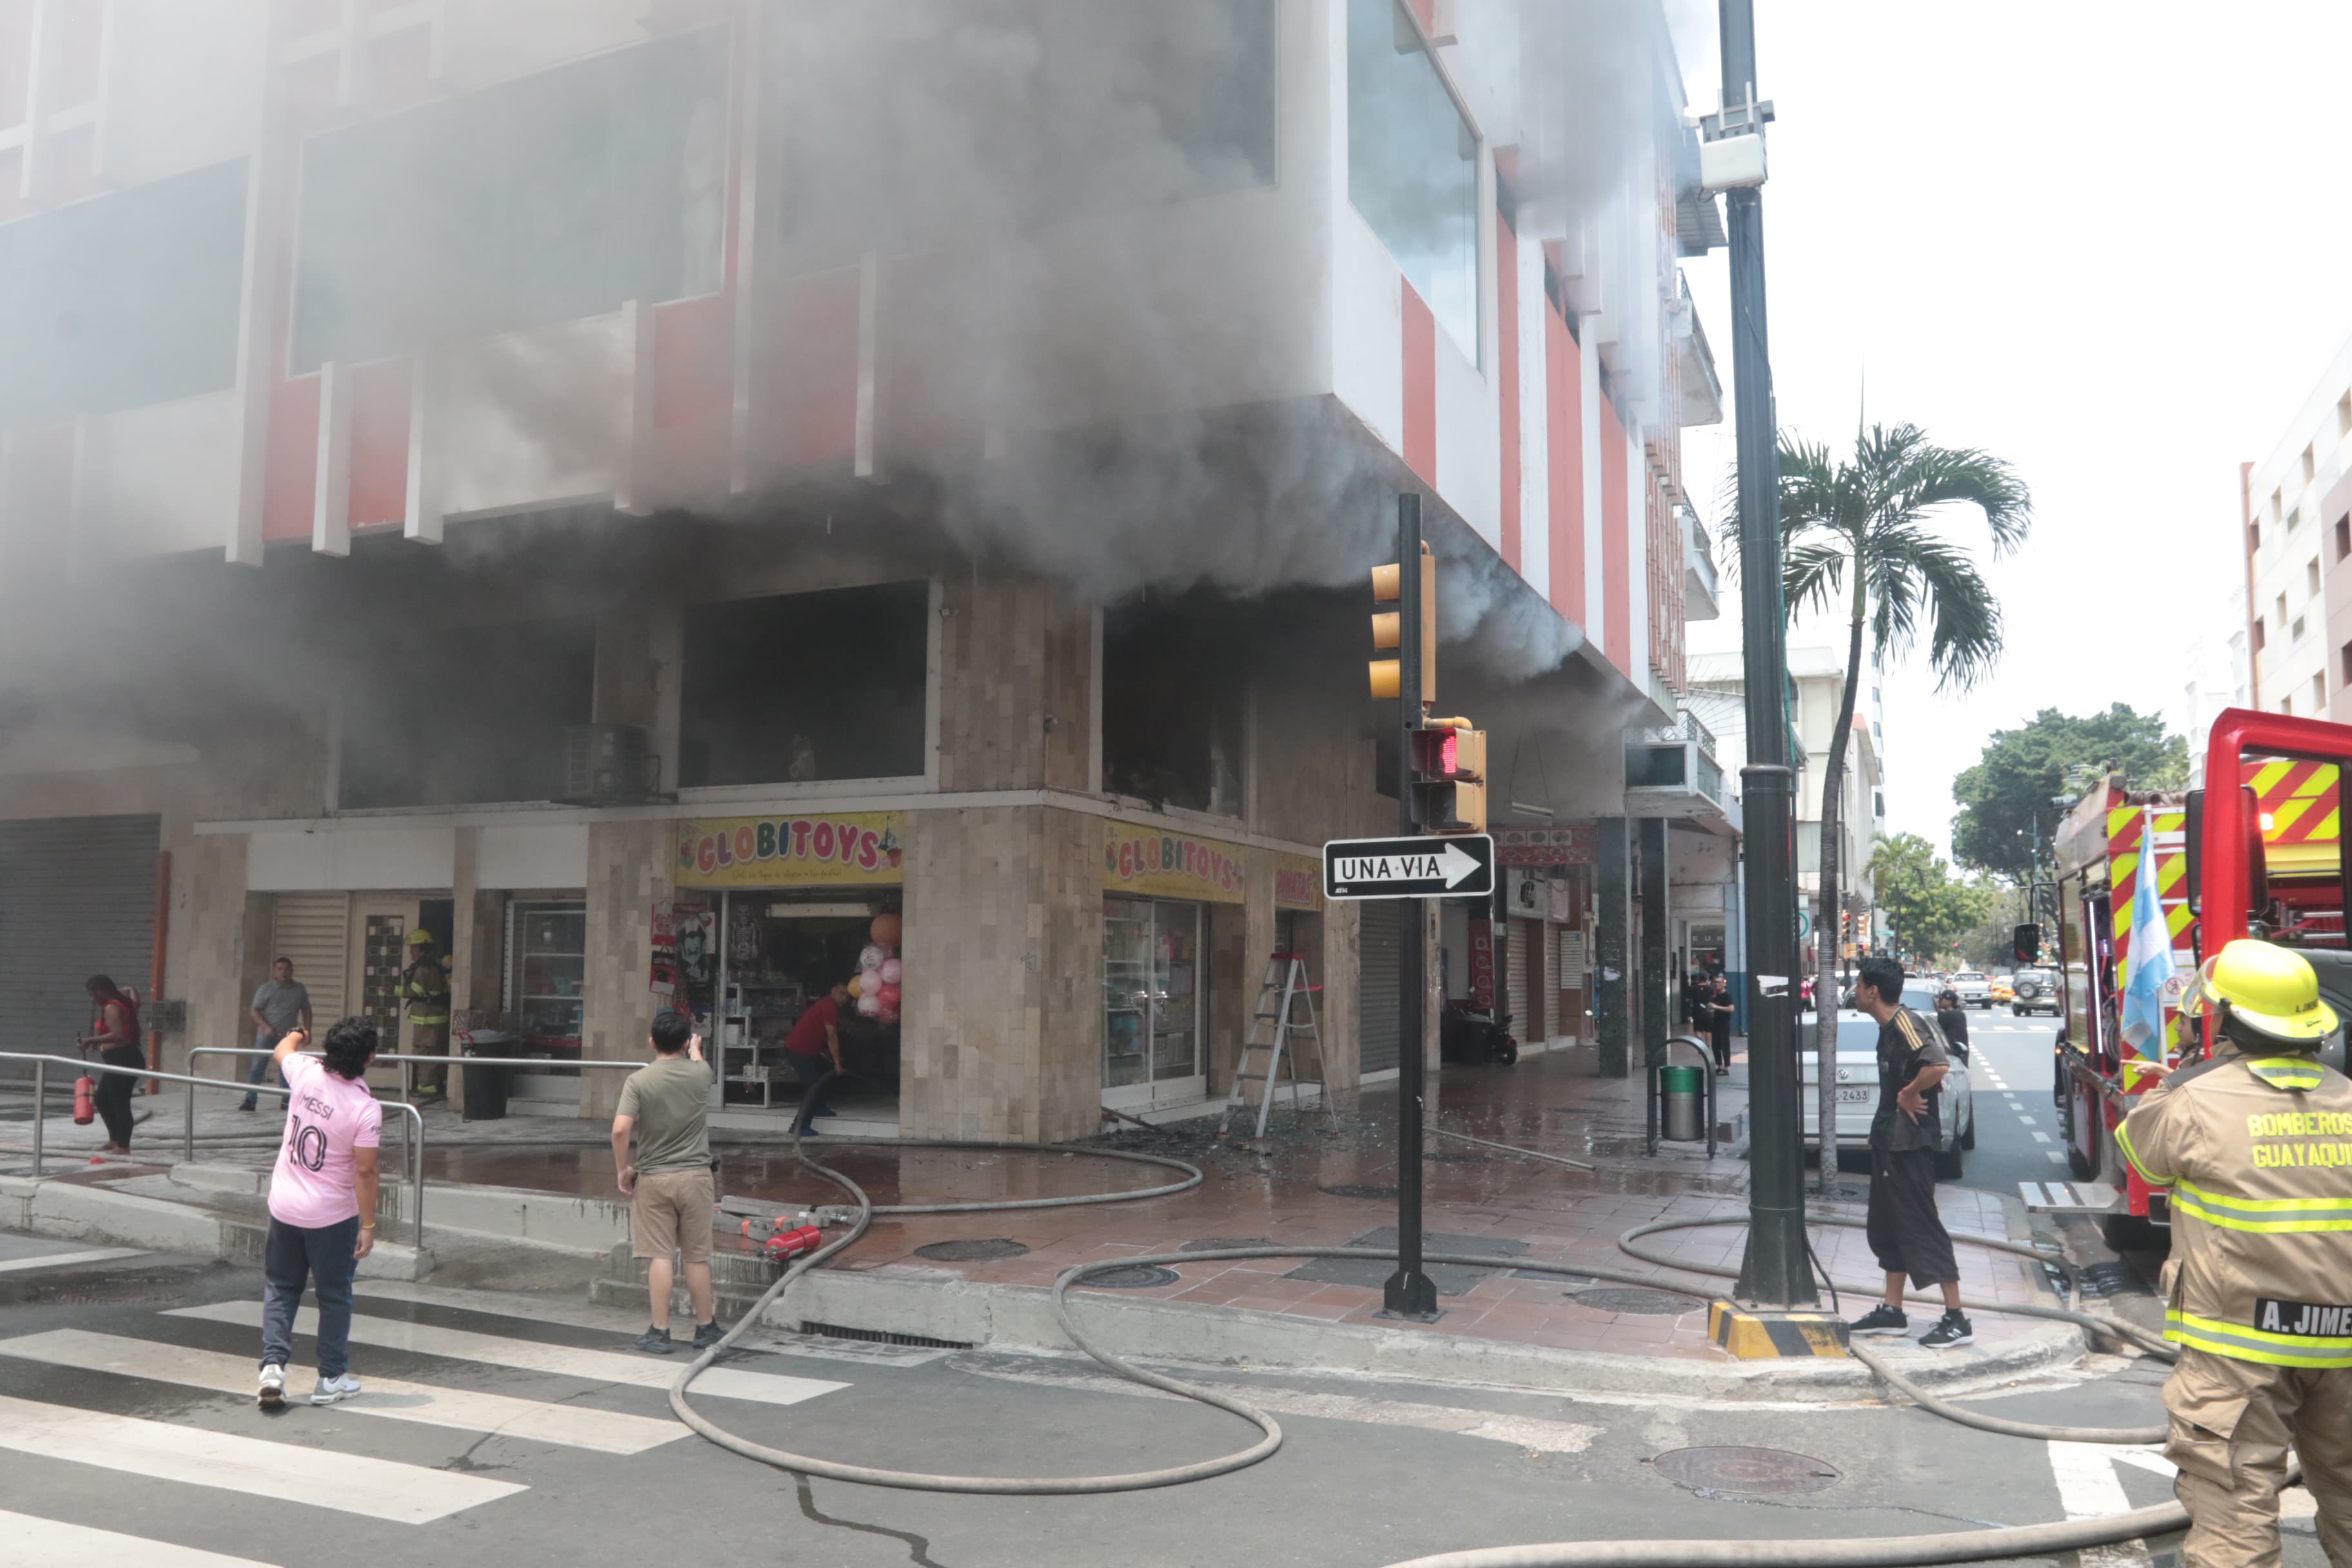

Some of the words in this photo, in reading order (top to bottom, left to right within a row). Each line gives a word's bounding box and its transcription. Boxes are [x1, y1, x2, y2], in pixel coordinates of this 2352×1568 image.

[696, 820, 879, 874] GLOBITOYS
[1119, 837, 1233, 892] GLOBITOYS
[1342, 858, 1391, 880] UNA
[1401, 856, 1441, 877] VIA
[300, 1094, 334, 1121] MESSI
[2247, 1112, 2352, 1137] BOMBEROS
[289, 1114, 327, 1172] 10
[2253, 1143, 2352, 1168] GUAYAQUI
[2262, 1300, 2289, 1332] A.
[2294, 1305, 2352, 1335] JIME
